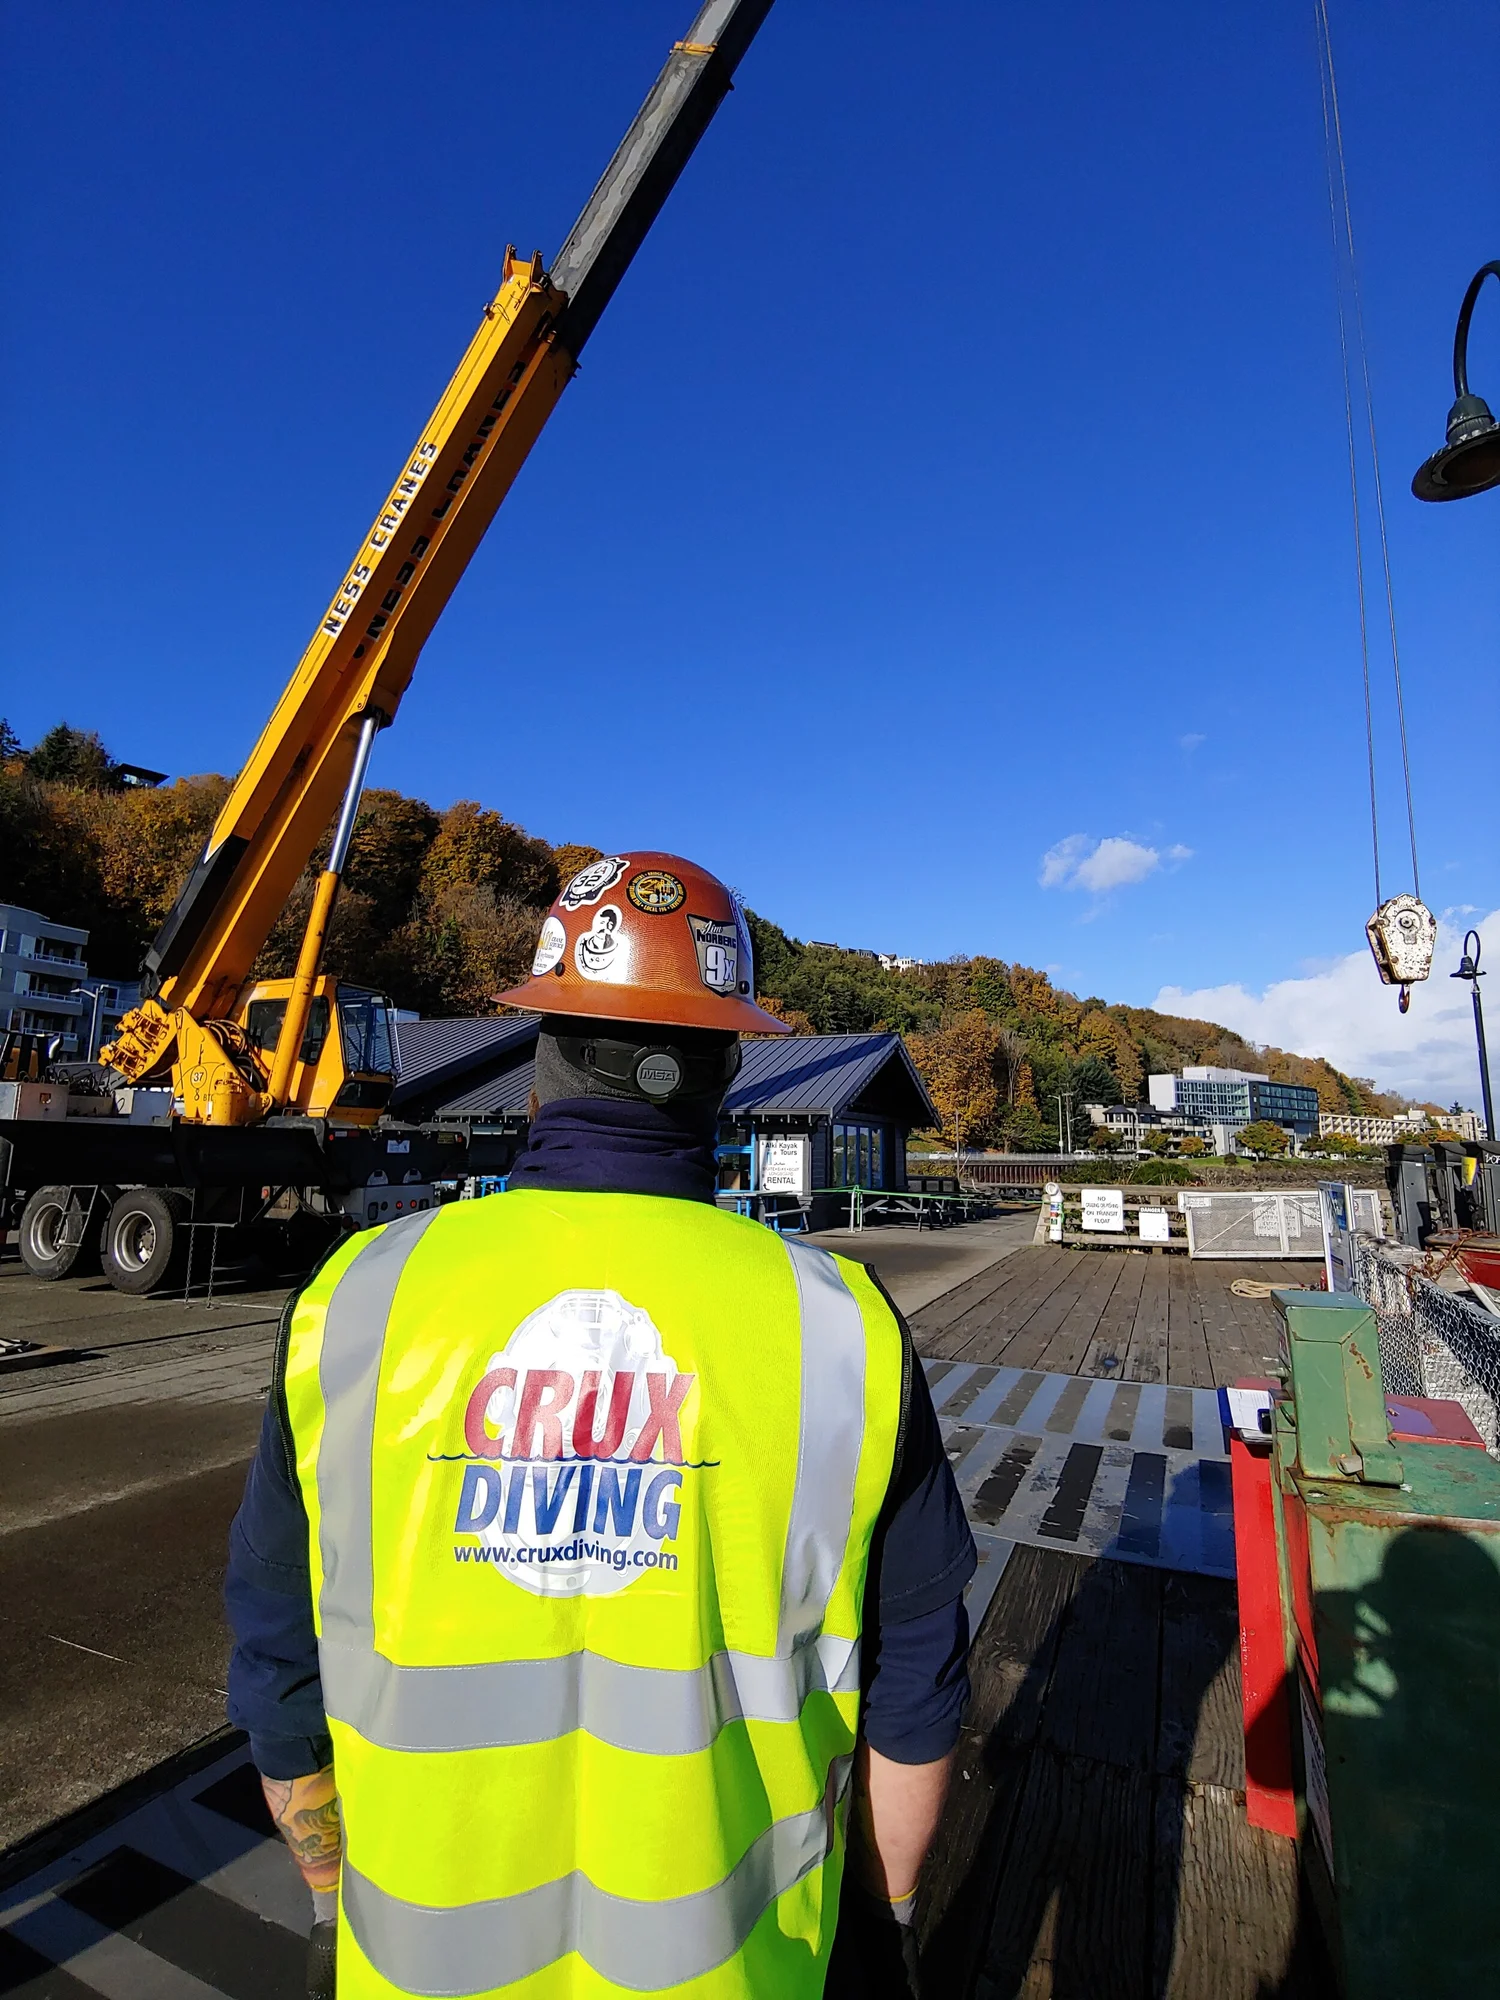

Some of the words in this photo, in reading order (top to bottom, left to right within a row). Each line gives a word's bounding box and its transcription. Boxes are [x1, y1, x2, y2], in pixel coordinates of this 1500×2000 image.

[322, 563, 372, 638] NESS
[369, 440, 438, 552] CRANES
[574, 875, 602, 888] 32
[702, 921, 723, 935] Jim
[697, 929, 736, 948] NORBERG
[193, 1072, 204, 1082] 37
[640, 1069, 676, 1081] MSA
[779, 1142, 798, 1150] Kayak
[464, 1367, 695, 1465] CRUX
[454, 1464, 683, 1541] DIVING
[453, 1538, 679, 1572] www.cruxdiving.com
